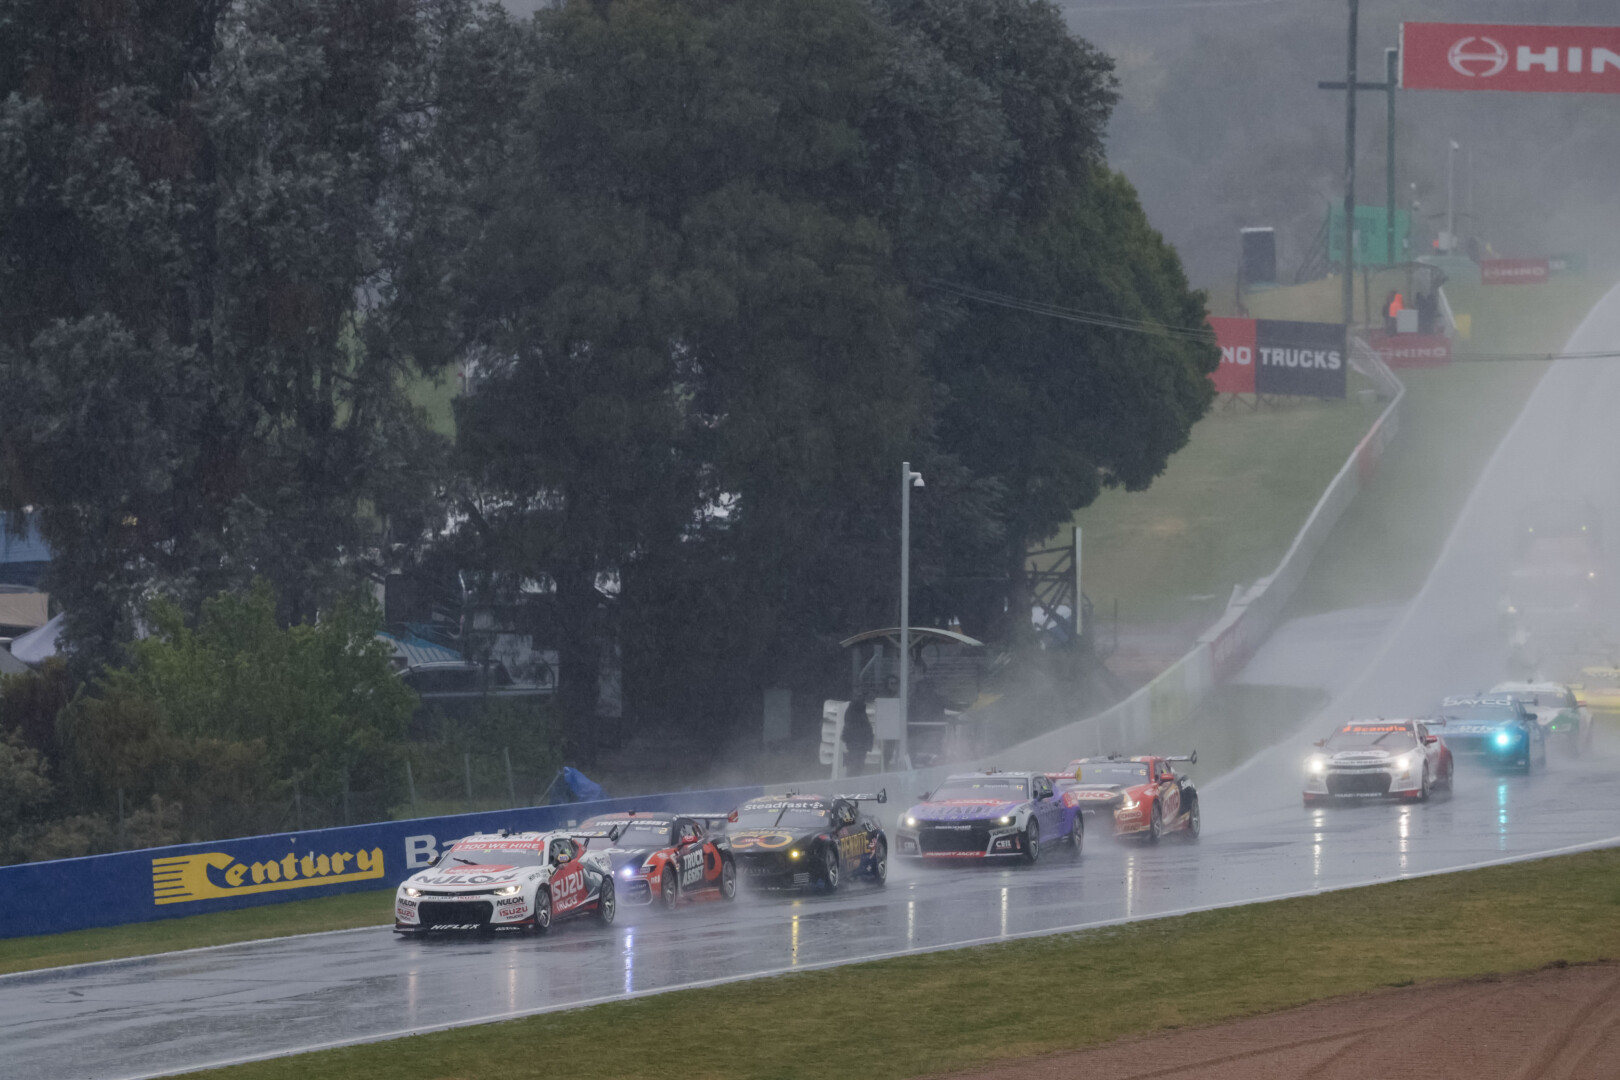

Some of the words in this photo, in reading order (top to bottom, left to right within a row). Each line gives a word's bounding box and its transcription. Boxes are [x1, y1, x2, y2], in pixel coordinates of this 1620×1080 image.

[1260, 348, 1341, 369] TRUCKS
[744, 802, 808, 811] Steadfast
[683, 849, 703, 869] TRUCK
[414, 873, 517, 885] NULON
[551, 870, 584, 901] ISUZU
[398, 898, 416, 907] NULON
[496, 896, 524, 906] NULON
[397, 908, 415, 917] ISUZU
[499, 906, 528, 917] ISUZU
[430, 923, 480, 931] HIFLEX
